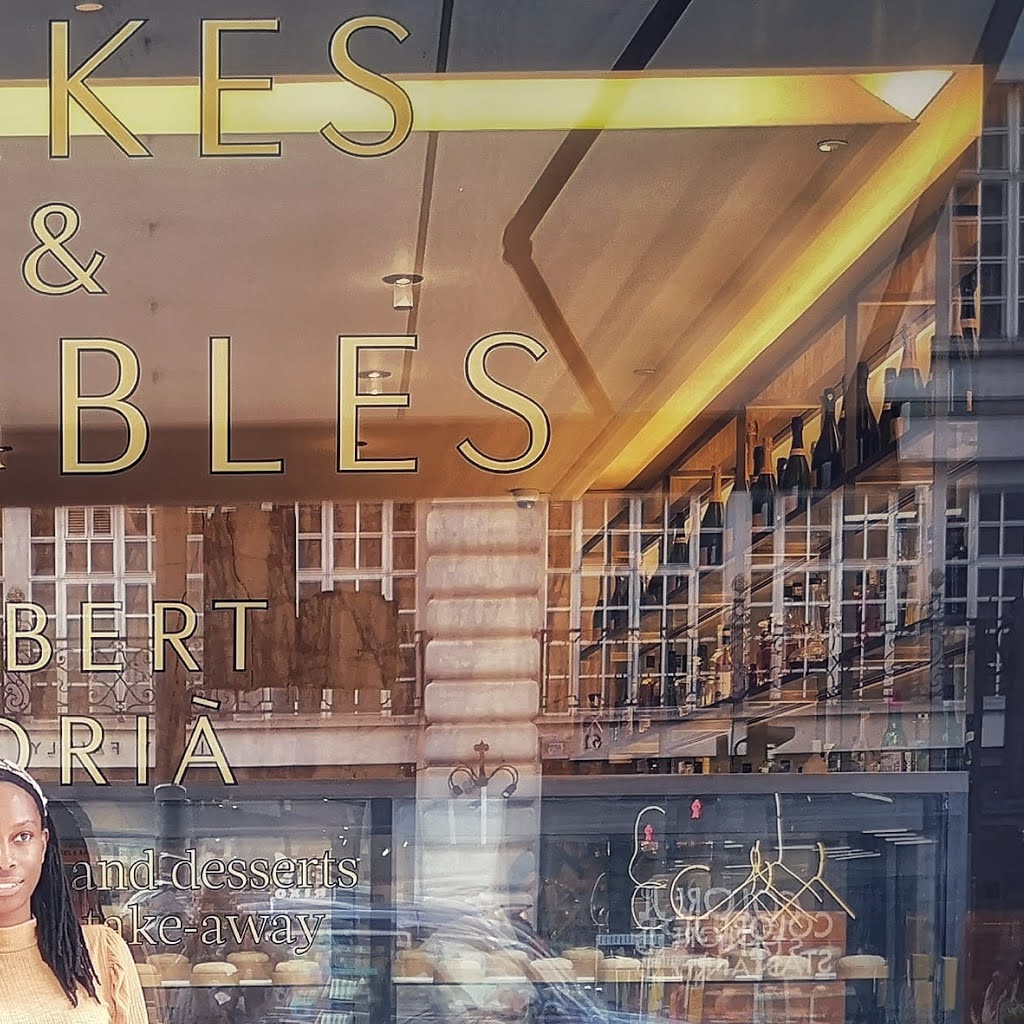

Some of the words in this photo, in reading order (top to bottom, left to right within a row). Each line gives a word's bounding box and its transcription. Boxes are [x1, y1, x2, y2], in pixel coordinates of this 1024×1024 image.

[21, 202, 108, 296] &
[71, 848, 160, 891] and
[171, 848, 359, 891] desserts
